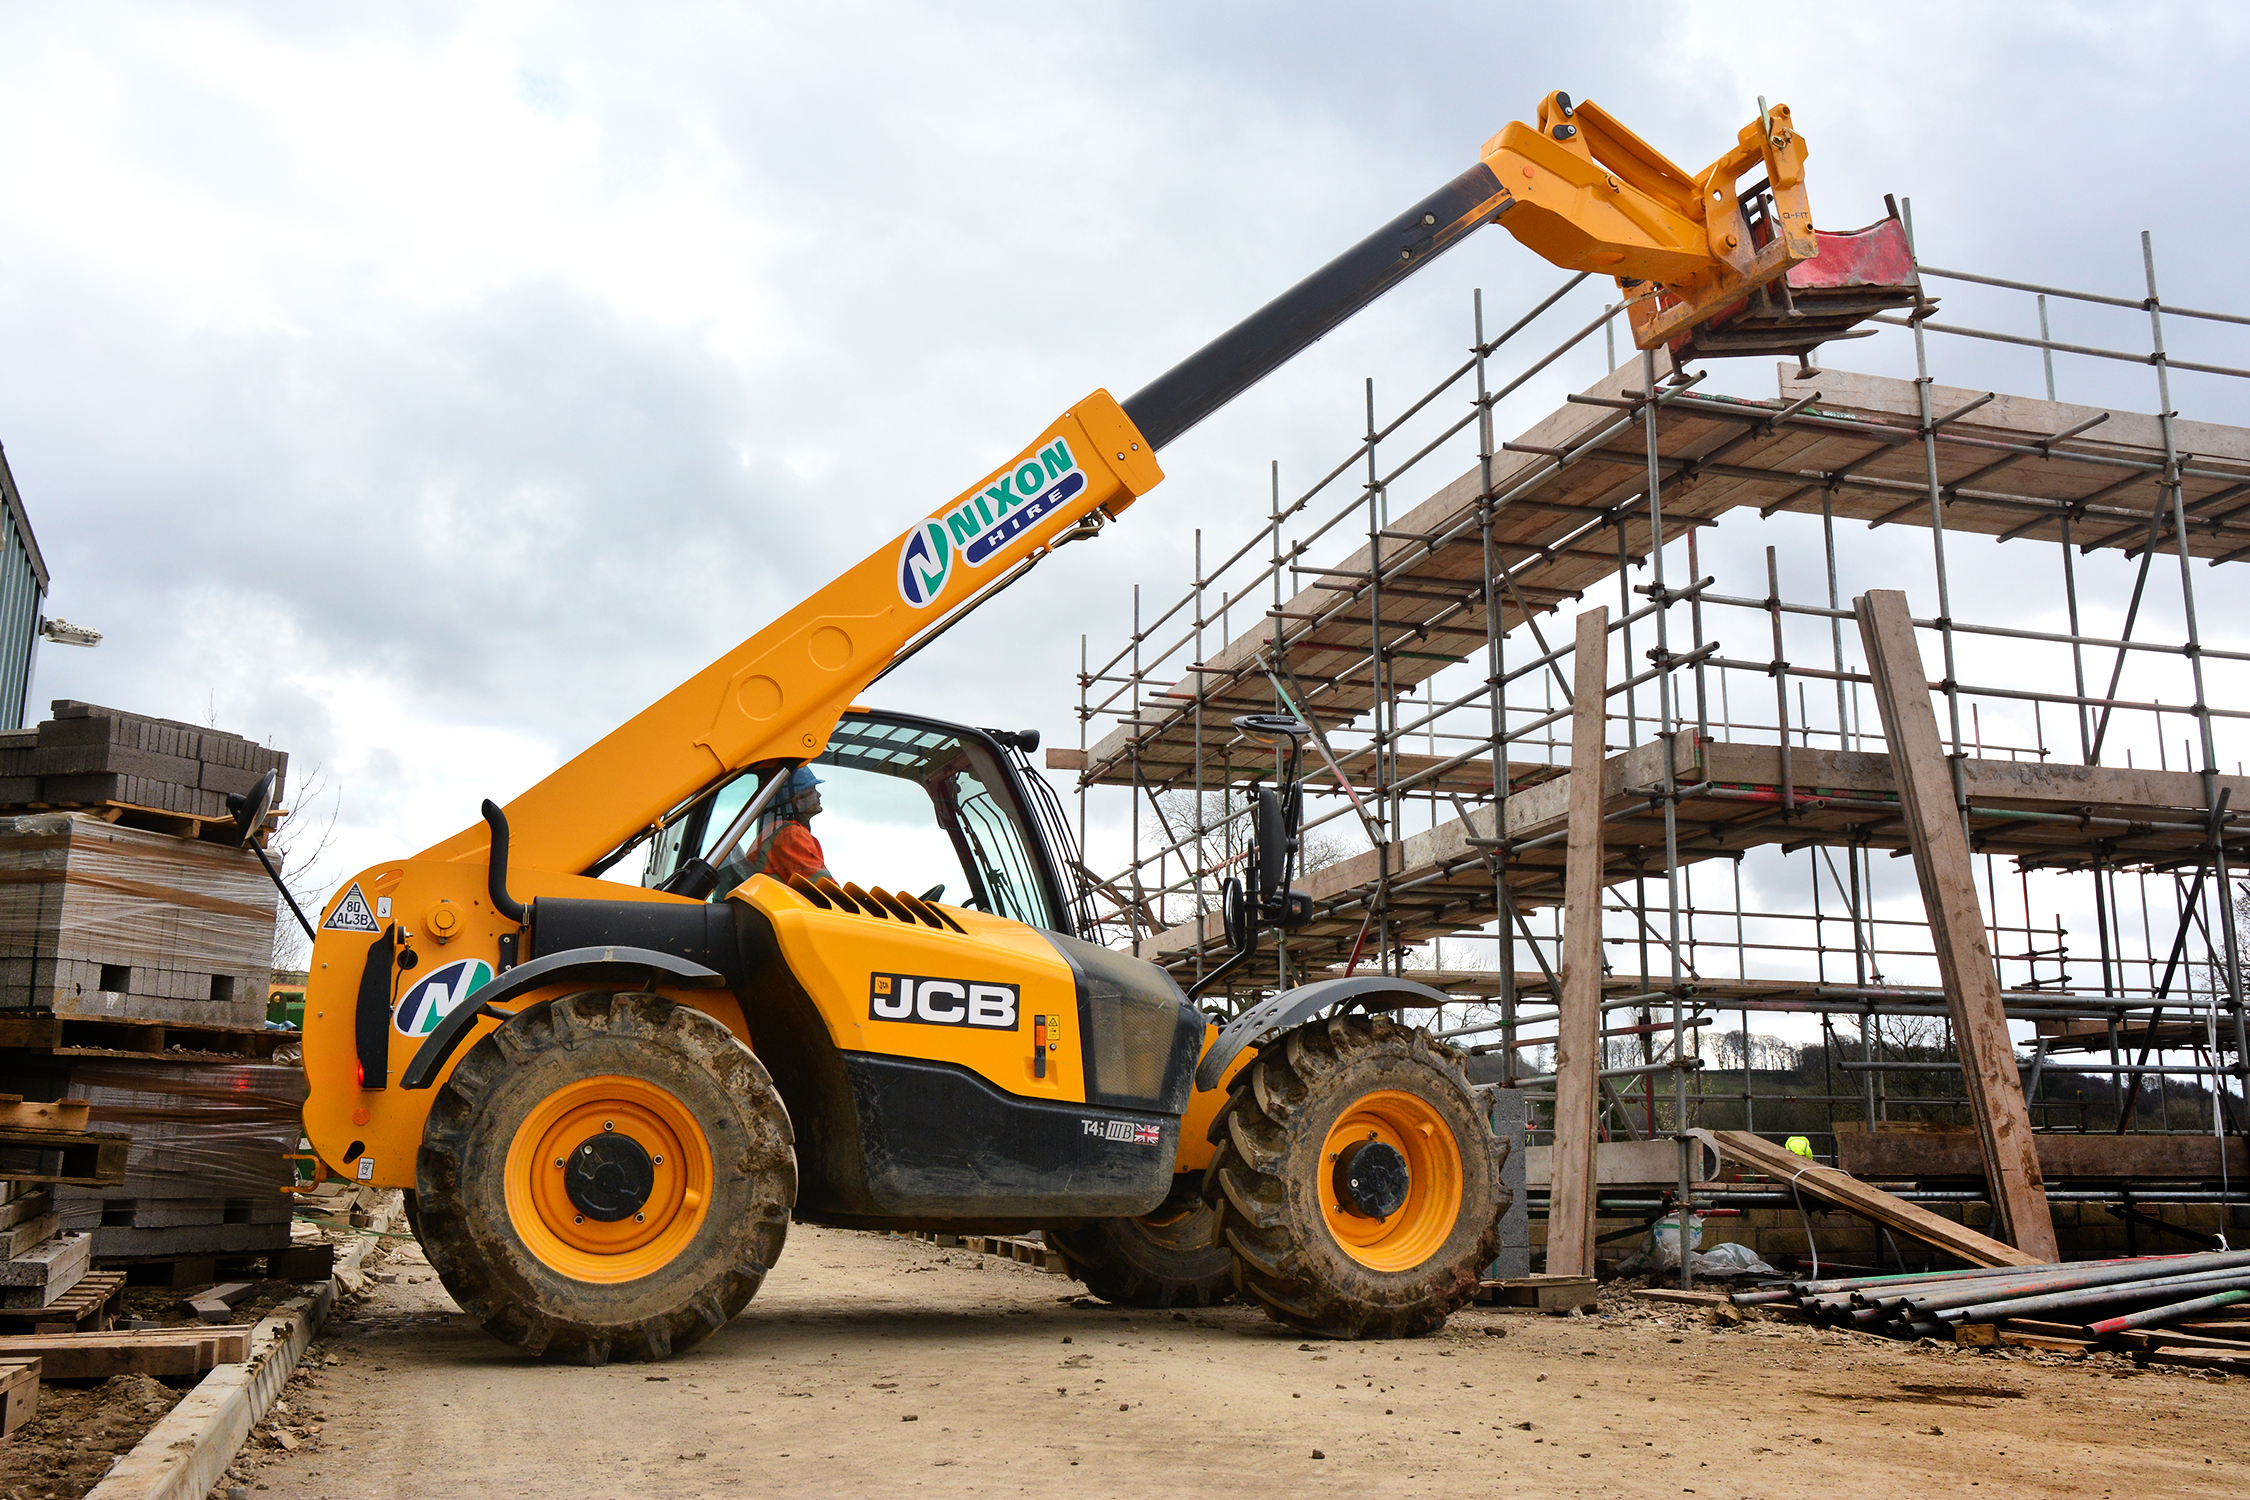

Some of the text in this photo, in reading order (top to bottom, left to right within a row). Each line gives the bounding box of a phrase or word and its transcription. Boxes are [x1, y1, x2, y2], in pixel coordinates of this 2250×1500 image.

[1782, 211, 1809, 220] Q-FIT
[946, 440, 1074, 546] NIXON
[987, 487, 1063, 548] HIRE
[337, 913, 369, 926] AL3B
[873, 978, 1016, 1027] JCB
[1081, 1119, 1105, 1137] T4i
